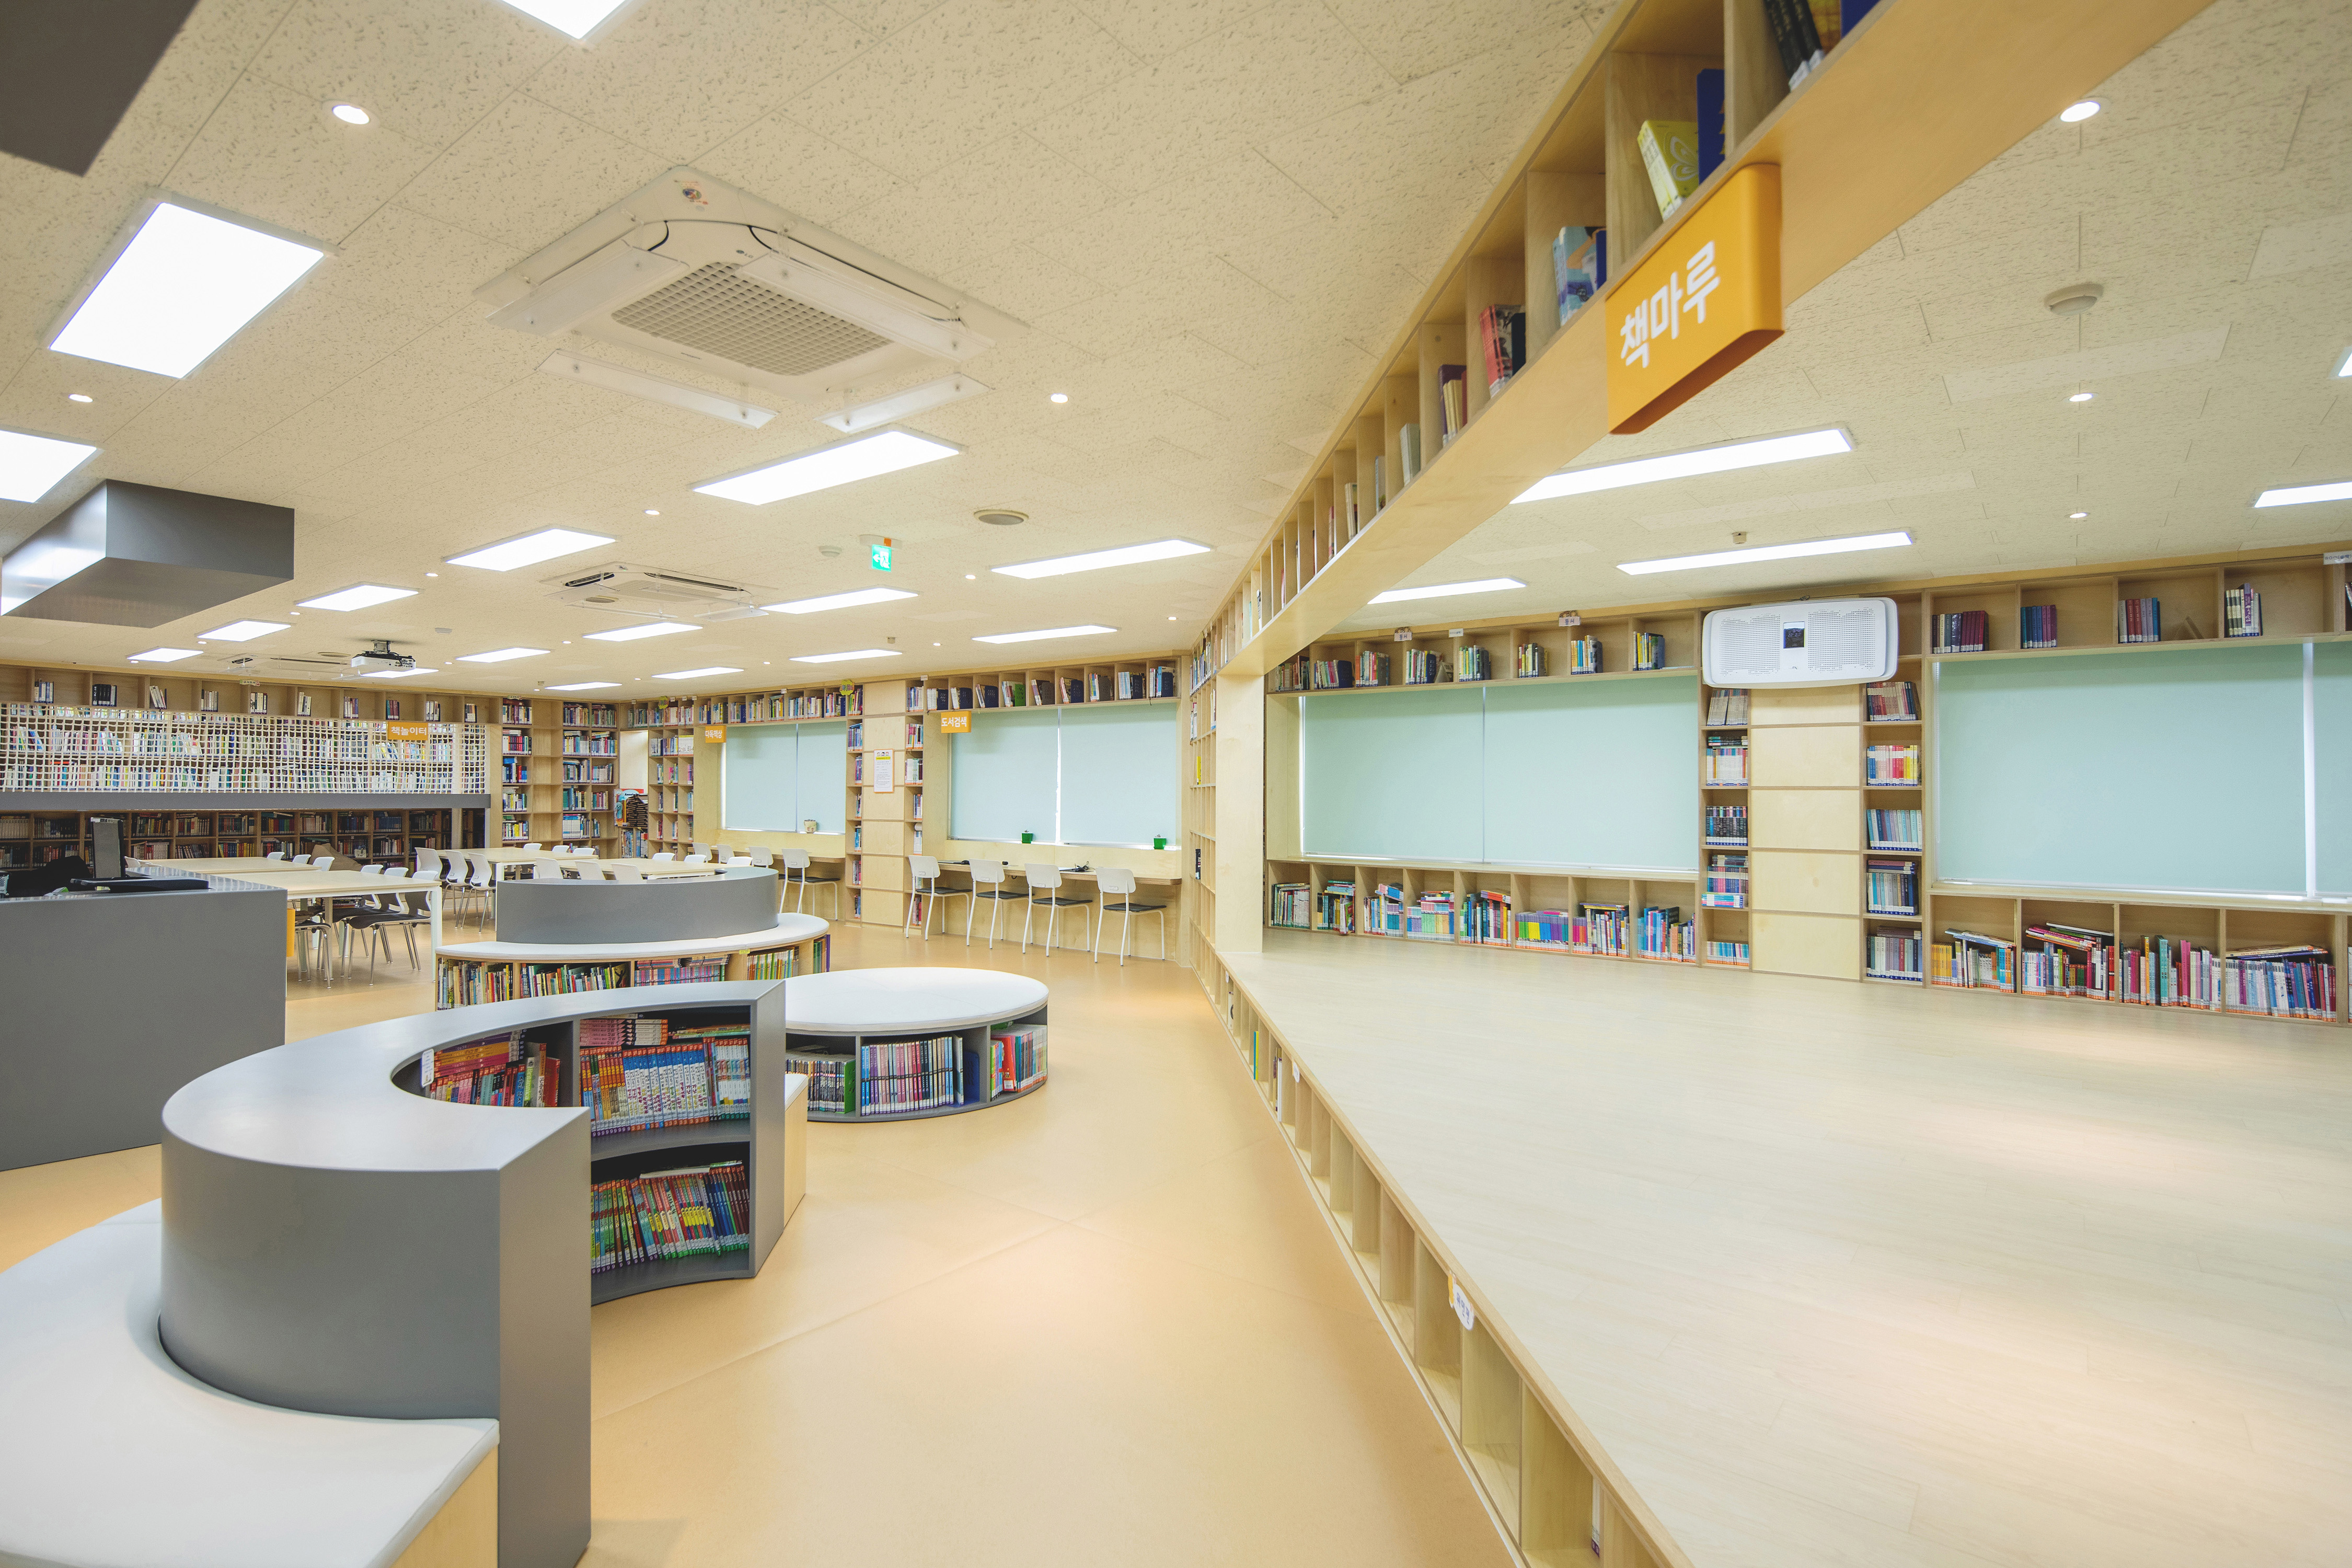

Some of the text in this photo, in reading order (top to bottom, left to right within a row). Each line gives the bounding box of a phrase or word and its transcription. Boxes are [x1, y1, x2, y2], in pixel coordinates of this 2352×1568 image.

[1620, 240, 1721, 368] 책마루
[391, 726, 426, 735] 책놀이터
[941, 717, 967, 727] 도서검색
[705, 730, 722, 739] 다독책상
[517, 1076, 524, 1104] 조선 왕조
[525, 1067, 533, 1101] Britannica
